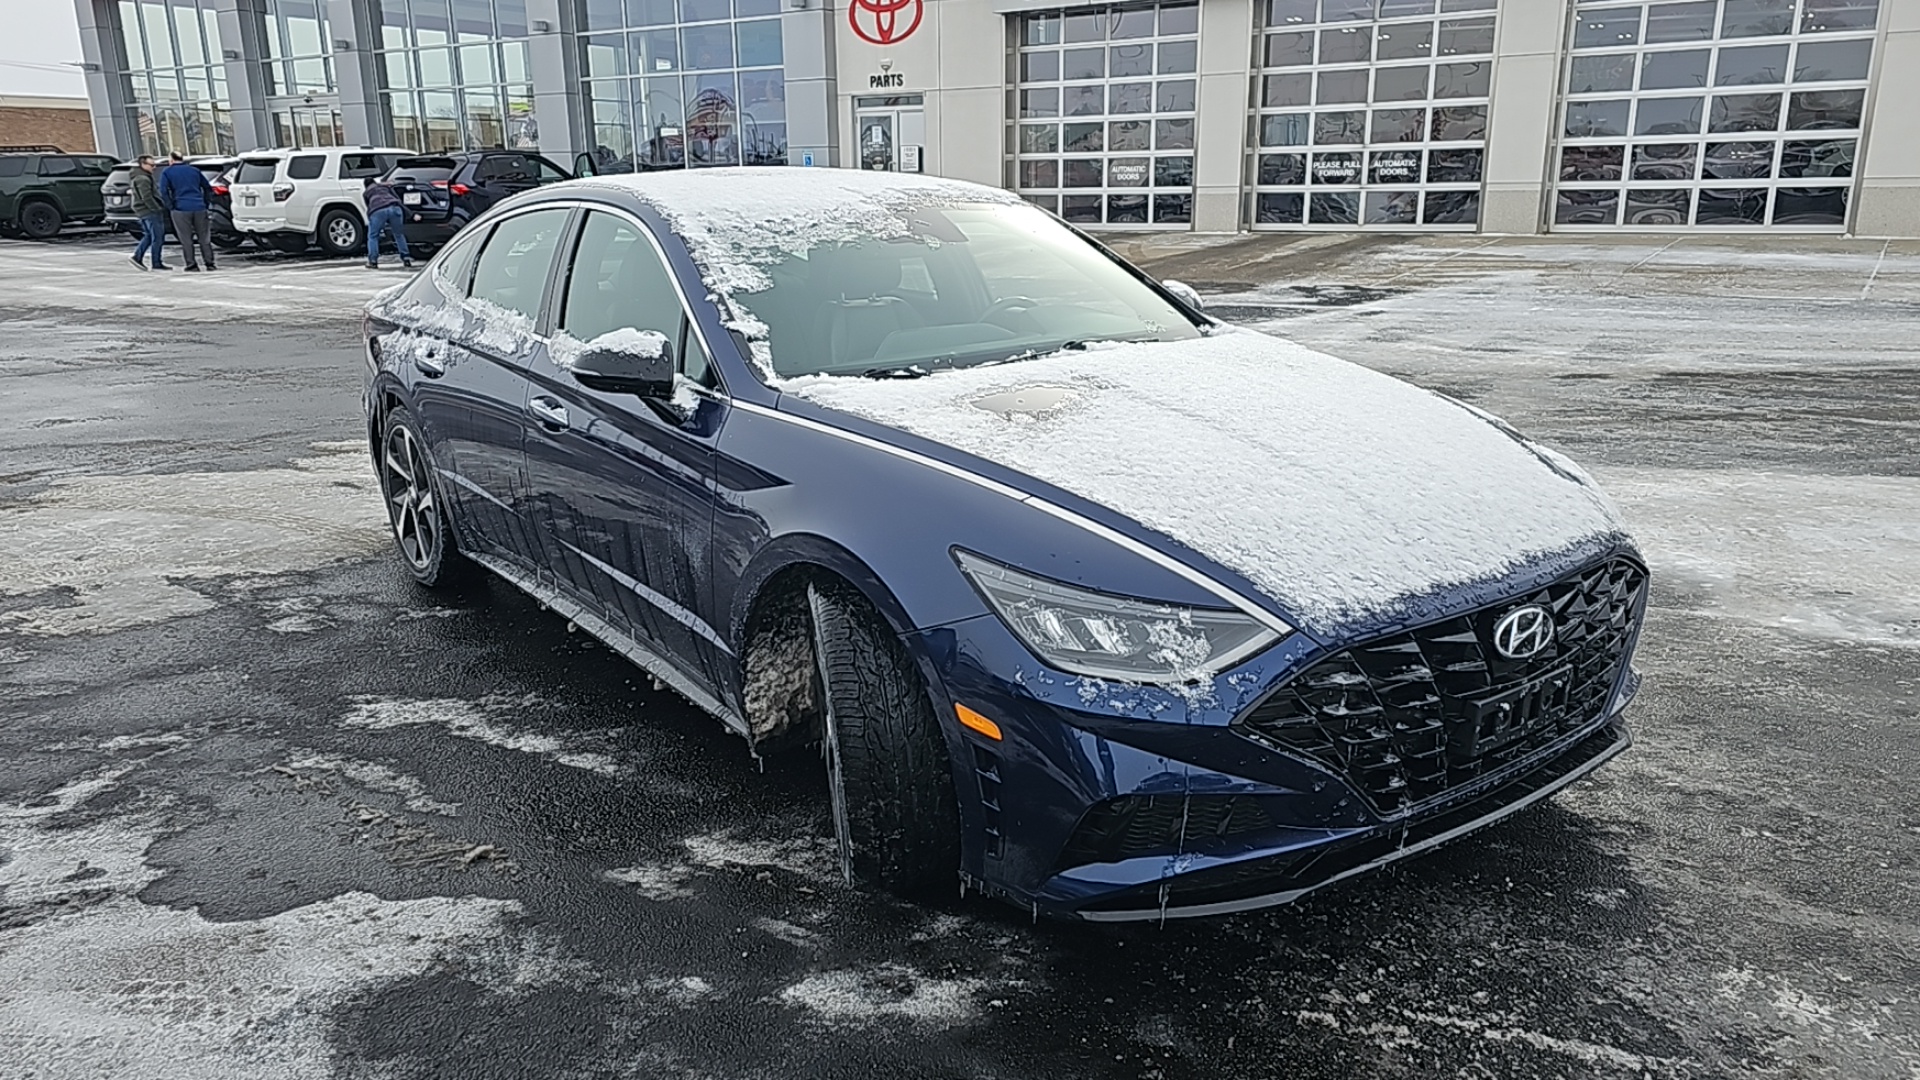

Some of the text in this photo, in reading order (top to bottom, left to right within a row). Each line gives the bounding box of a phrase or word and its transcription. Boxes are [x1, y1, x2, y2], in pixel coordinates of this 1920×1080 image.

[870, 73, 904, 88] PARTS
[1313, 160, 1361, 168] PLEASE PULL
[1374, 159, 1417, 167] AUTOMATIC
[1111, 165, 1147, 173] AUTOMATIC
[1318, 169, 1355, 177] FORWARD
[1380, 168, 1409, 176] DOORS
